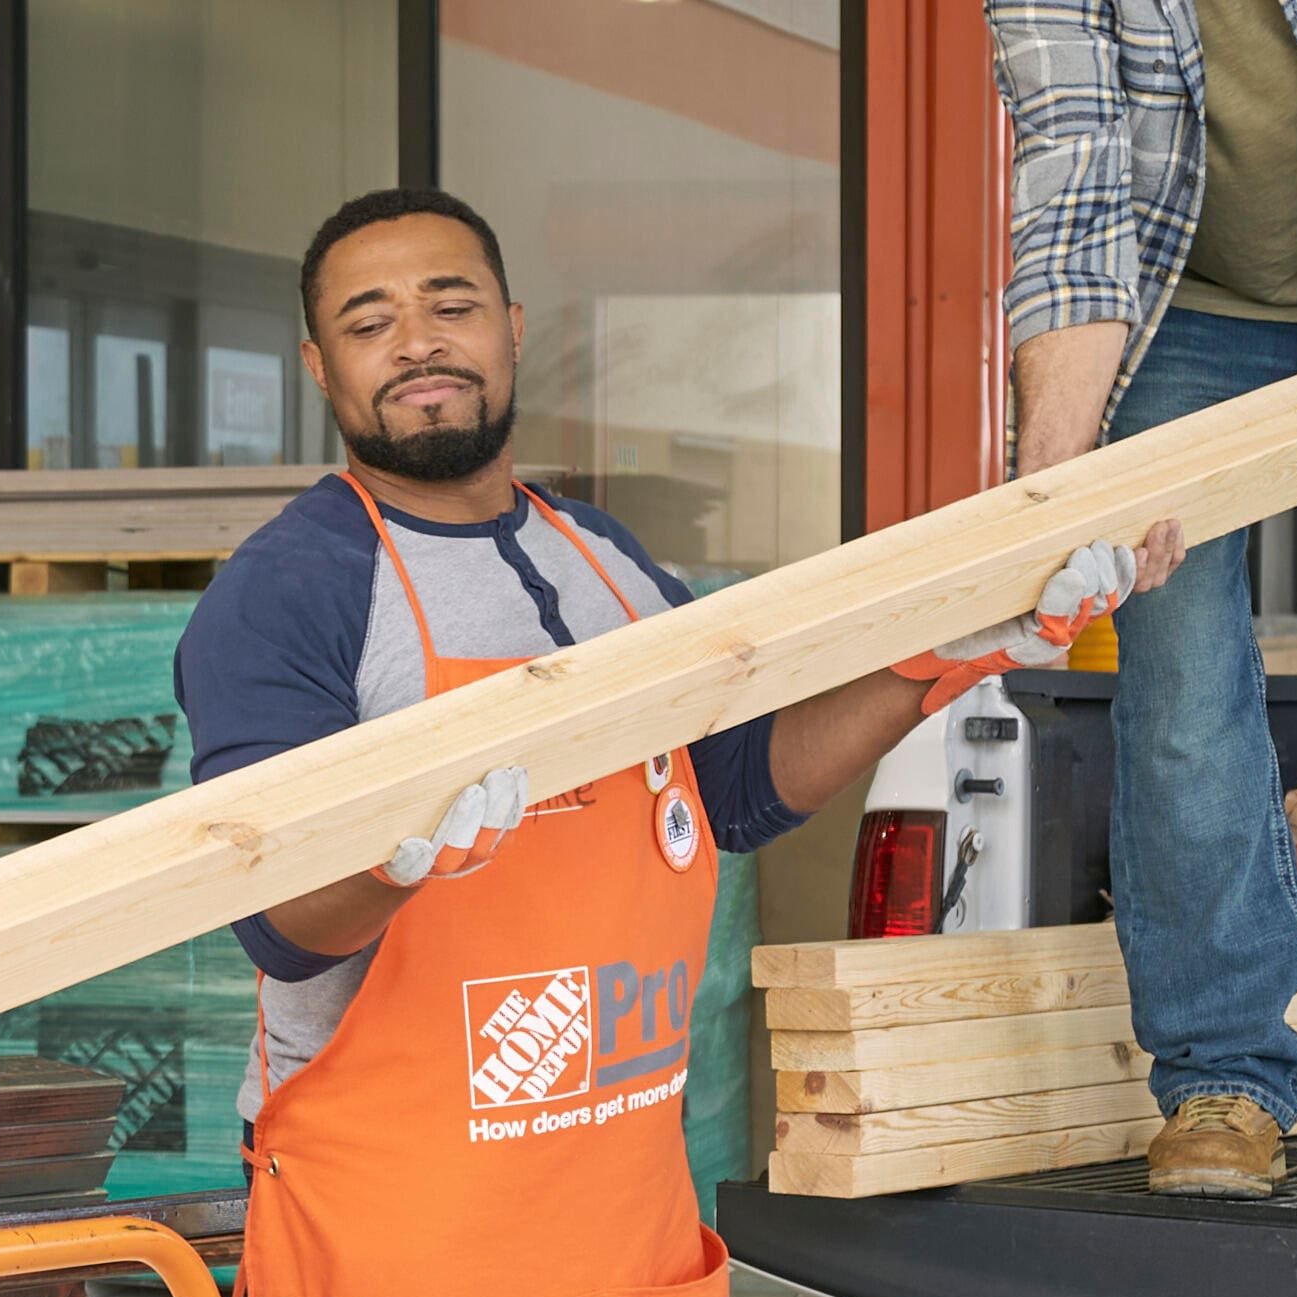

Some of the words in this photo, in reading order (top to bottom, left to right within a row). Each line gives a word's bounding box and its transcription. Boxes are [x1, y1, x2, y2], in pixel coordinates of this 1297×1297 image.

[472, 972, 590, 1105] HOME
[480, 989, 532, 1043] THE
[596, 960, 688, 1056] Pro
[520, 1014, 590, 1101] DEPOT
[469, 1117, 527, 1142] How
[532, 1106, 591, 1135] doers
[595, 1094, 625, 1124] get
[628, 1083, 669, 1112] more
